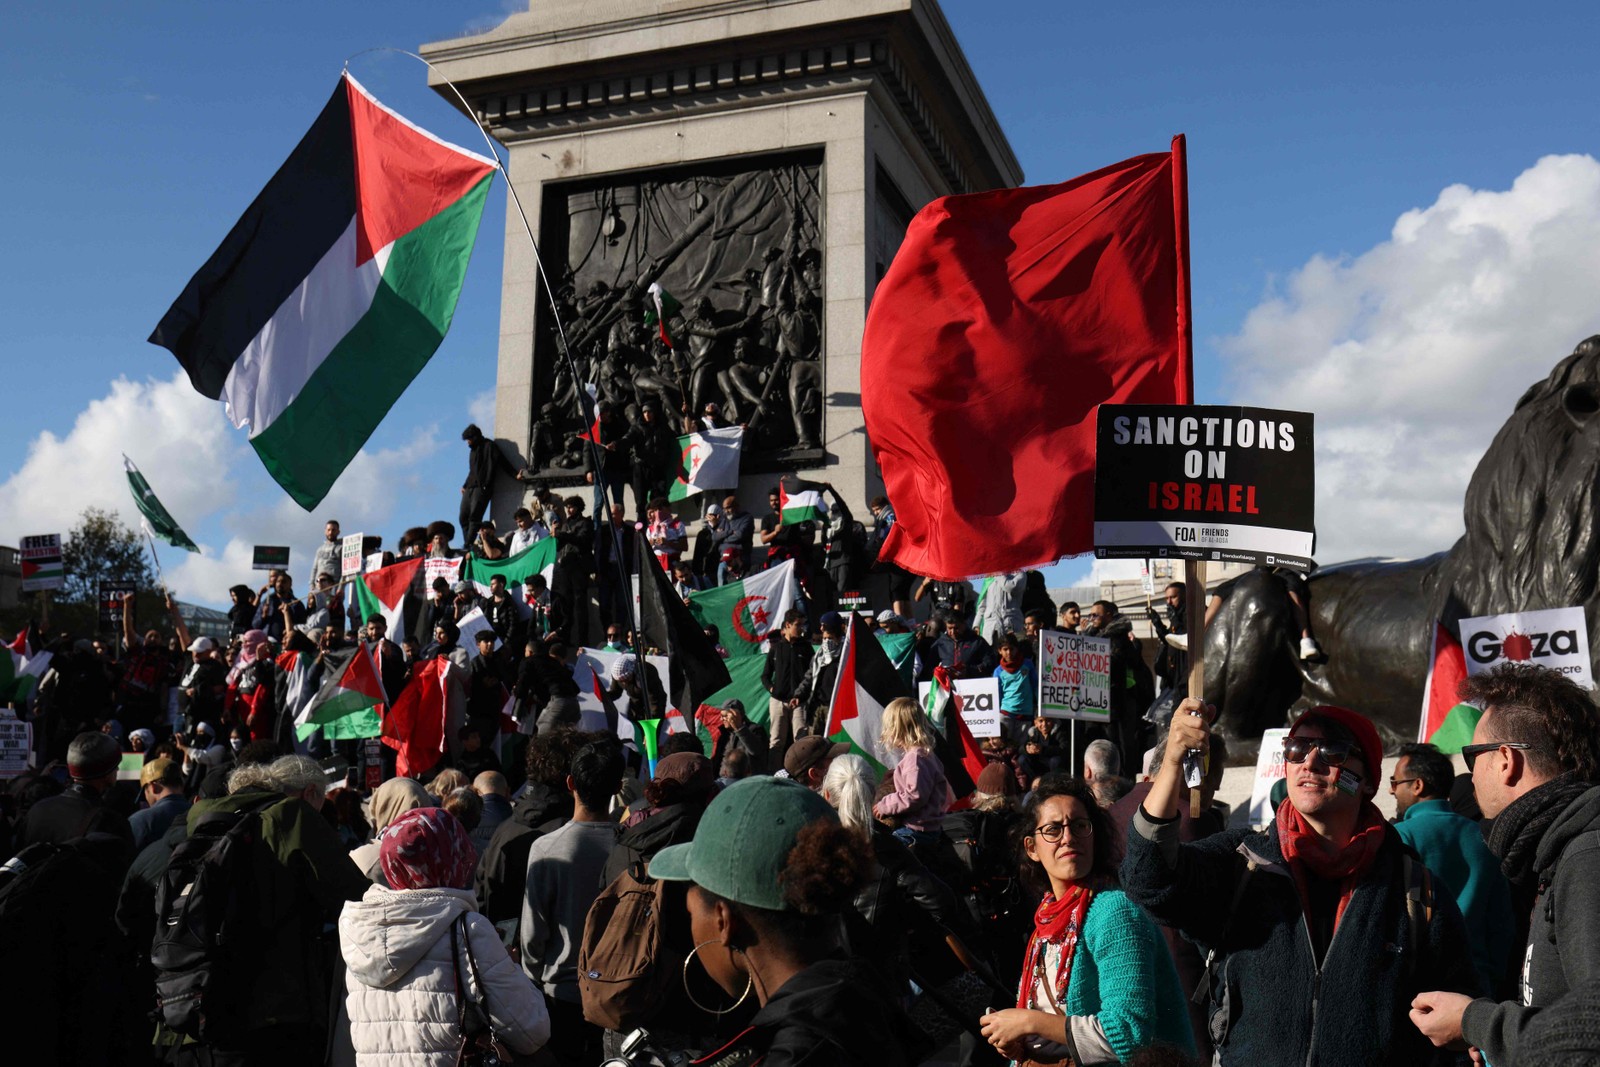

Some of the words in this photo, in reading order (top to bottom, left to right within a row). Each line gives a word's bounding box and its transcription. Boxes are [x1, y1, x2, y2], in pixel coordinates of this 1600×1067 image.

[1113, 415, 1295, 452] SANCTIONS
[1184, 450, 1226, 479] ON
[1148, 482, 1260, 514] ISRAEL
[25, 535, 56, 549] FREE
[1175, 527, 1196, 542] FOA
[1201, 528, 1229, 538] FRIENDS
[21, 547, 60, 558] PALESTINE
[838, 597, 867, 605] BOMBING
[1057, 636, 1085, 652] STOP!
[1085, 642, 1097, 651] THIS
[1468, 629, 1579, 664] Gza
[1065, 651, 1109, 673] GENOCIDE
[1051, 667, 1081, 685] STAND
[1085, 671, 1110, 689] TRUTH
[1042, 686, 1070, 704] FREE
